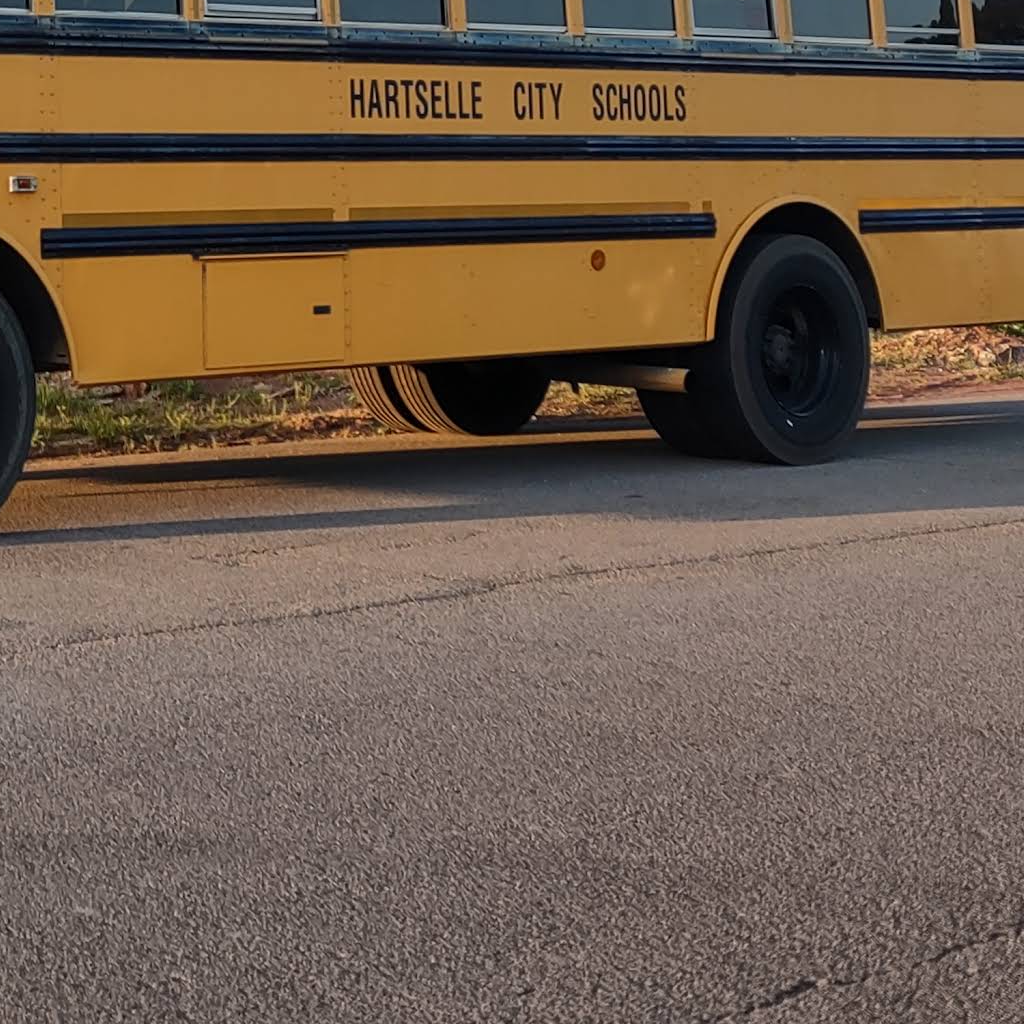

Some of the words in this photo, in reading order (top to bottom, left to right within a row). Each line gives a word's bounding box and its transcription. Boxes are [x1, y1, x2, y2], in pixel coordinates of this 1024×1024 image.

[350, 79, 483, 119] HARTSELLE
[513, 81, 563, 120] CITY
[592, 83, 687, 121] SCHOOLS
